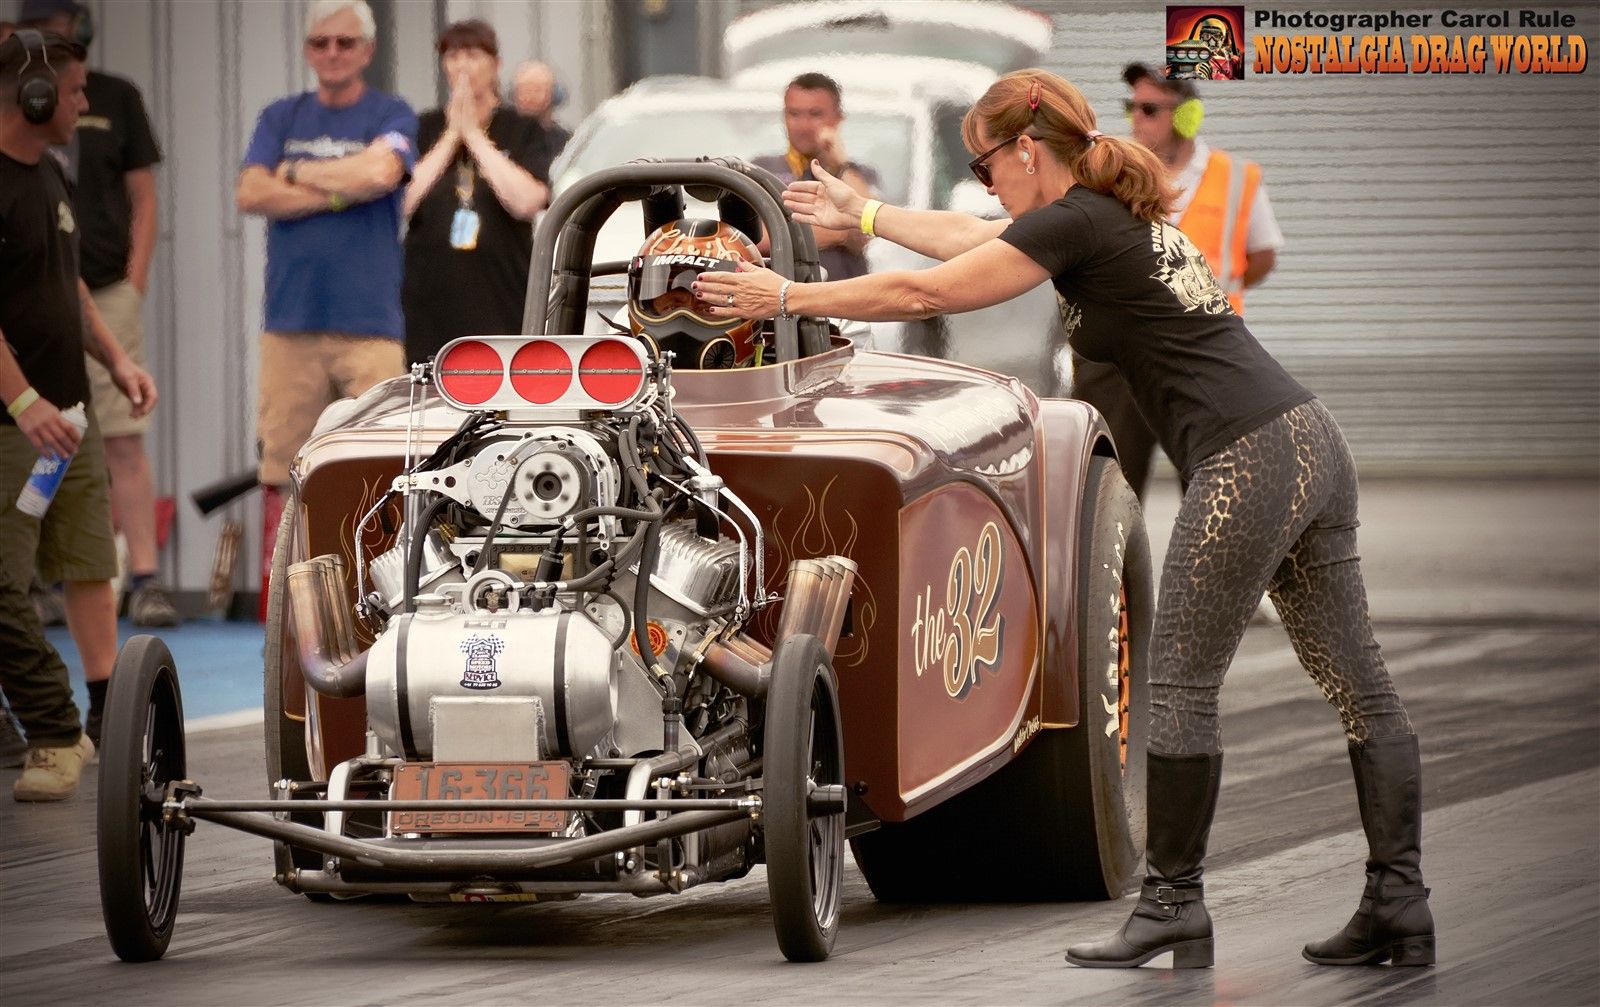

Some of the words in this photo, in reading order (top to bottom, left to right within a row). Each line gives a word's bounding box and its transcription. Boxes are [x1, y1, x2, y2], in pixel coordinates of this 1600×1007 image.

[651, 255, 720, 269] IMPACT
[911, 584, 947, 677] the
[944, 521, 1004, 702] 32
[415, 766, 549, 800] 16-366
